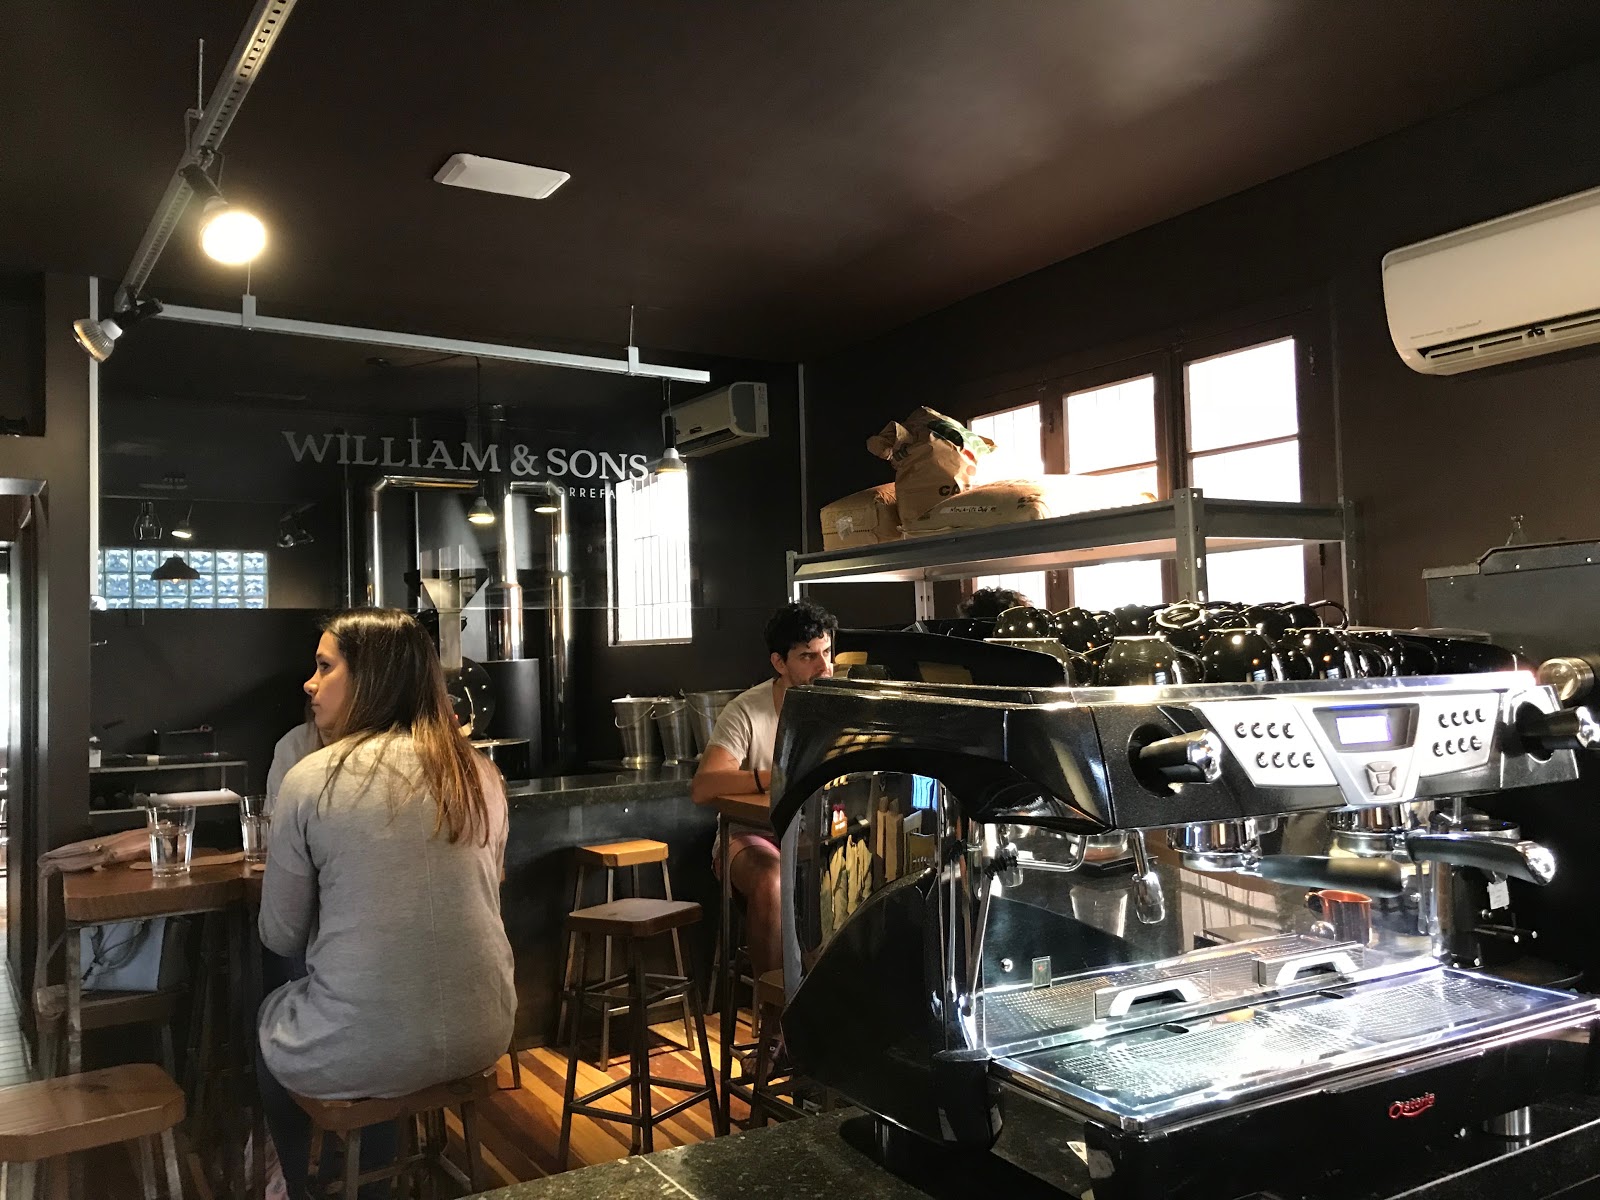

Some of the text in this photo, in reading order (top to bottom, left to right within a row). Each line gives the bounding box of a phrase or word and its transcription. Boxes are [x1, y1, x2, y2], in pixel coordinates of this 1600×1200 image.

[281, 430, 649, 481] WILLIAM & SONS
